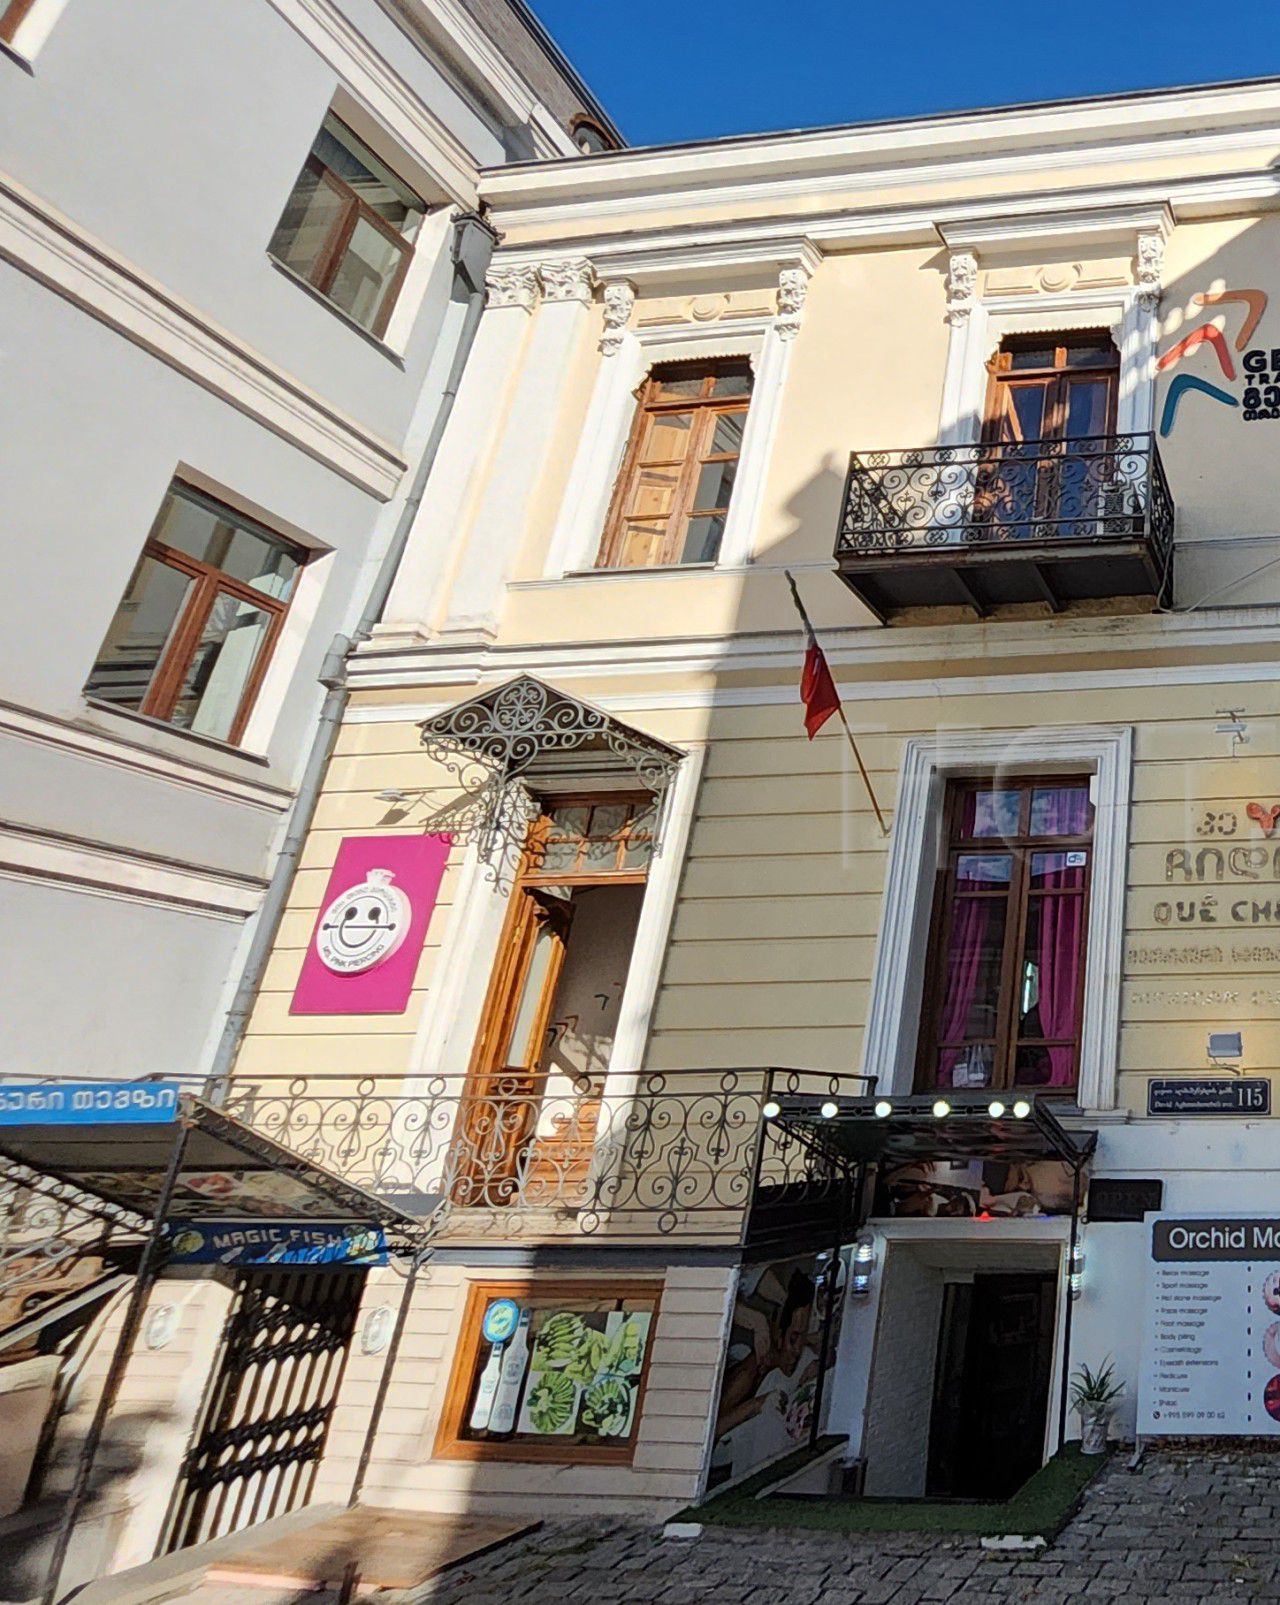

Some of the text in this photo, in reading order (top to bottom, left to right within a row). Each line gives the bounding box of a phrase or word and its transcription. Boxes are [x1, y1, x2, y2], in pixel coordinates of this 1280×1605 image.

[1238, 1088, 1263, 1107] 115
[213, 1228, 342, 1249] MAGIC FISH
[1168, 1226, 1246, 1250] Orchid
